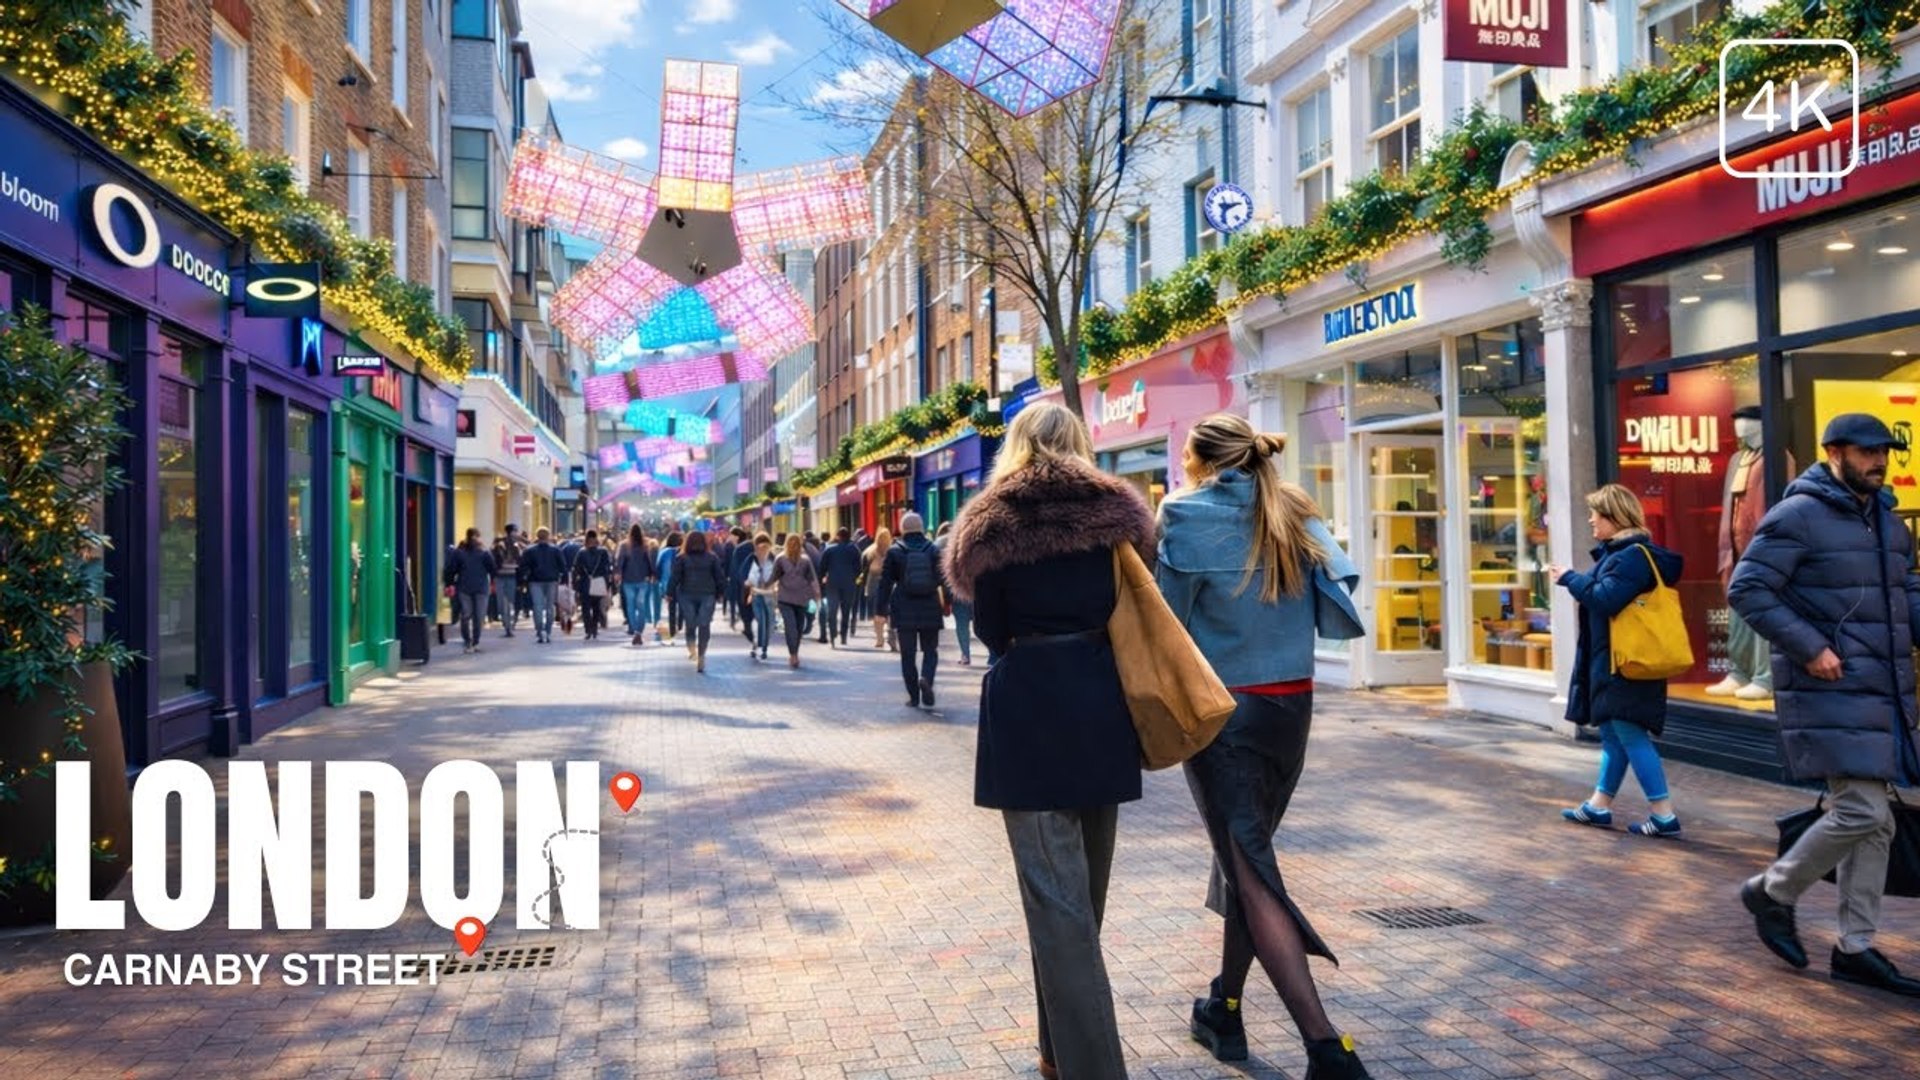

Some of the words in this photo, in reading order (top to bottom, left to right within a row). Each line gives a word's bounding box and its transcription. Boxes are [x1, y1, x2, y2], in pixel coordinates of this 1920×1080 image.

[1469, 0, 1549, 30] MUJI
[1, 171, 59, 223] bloom
[1756, 139, 1843, 213] MUJI
